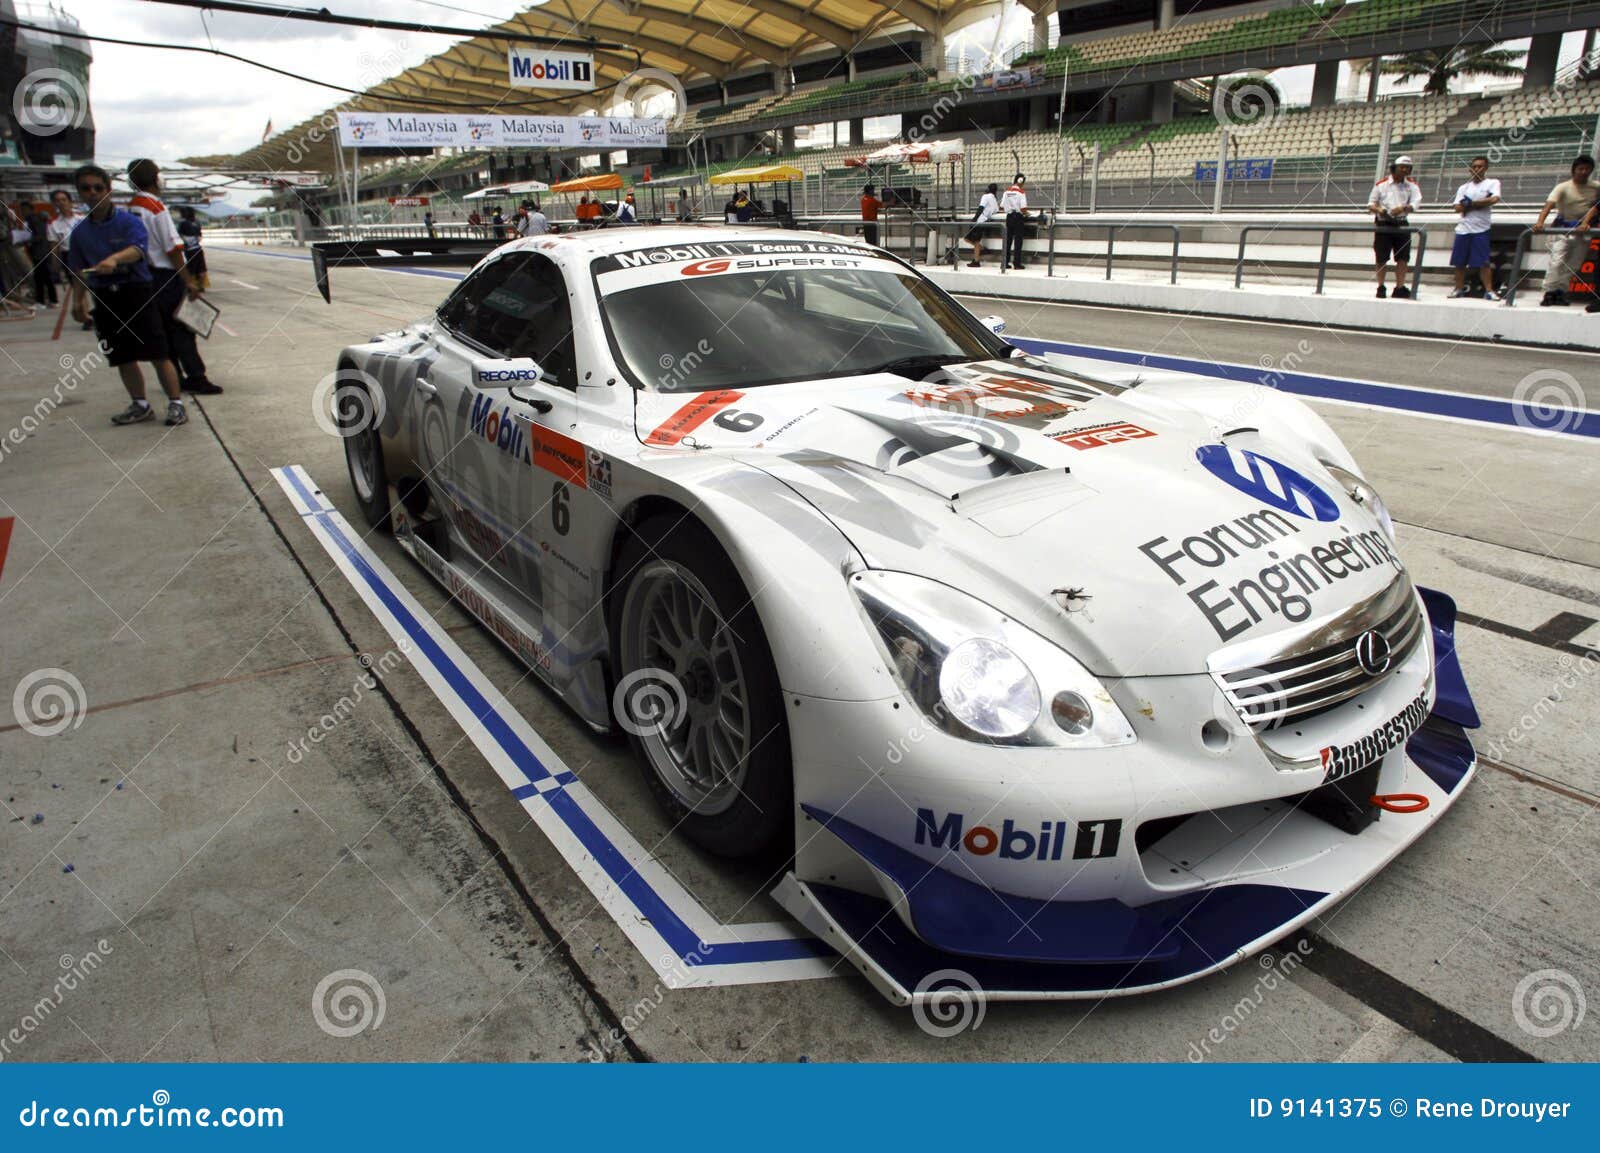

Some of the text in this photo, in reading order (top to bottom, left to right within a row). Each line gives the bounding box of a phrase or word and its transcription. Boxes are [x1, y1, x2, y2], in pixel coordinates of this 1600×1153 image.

[512, 57, 570, 80] Mobil
[387, 117, 457, 135] Malaysia
[502, 119, 565, 137] Malaysia
[609, 121, 665, 138] Malaysia
[615, 243, 711, 268] Mobil
[747, 243, 804, 254] Team
[736, 257, 825, 270] SUPER
[831, 258, 862, 268] GT
[478, 370, 537, 382] RECARO
[471, 392, 526, 459] Mobil
[713, 409, 765, 433] 6
[1054, 425, 1157, 450] TRD
[552, 481, 570, 536] 6
[1137, 509, 1301, 586] Forum
[1186, 525, 1401, 643] Engineering
[1320, 691, 1429, 784] BRIDGESTONE
[915, 808, 1066, 860] Mobil
